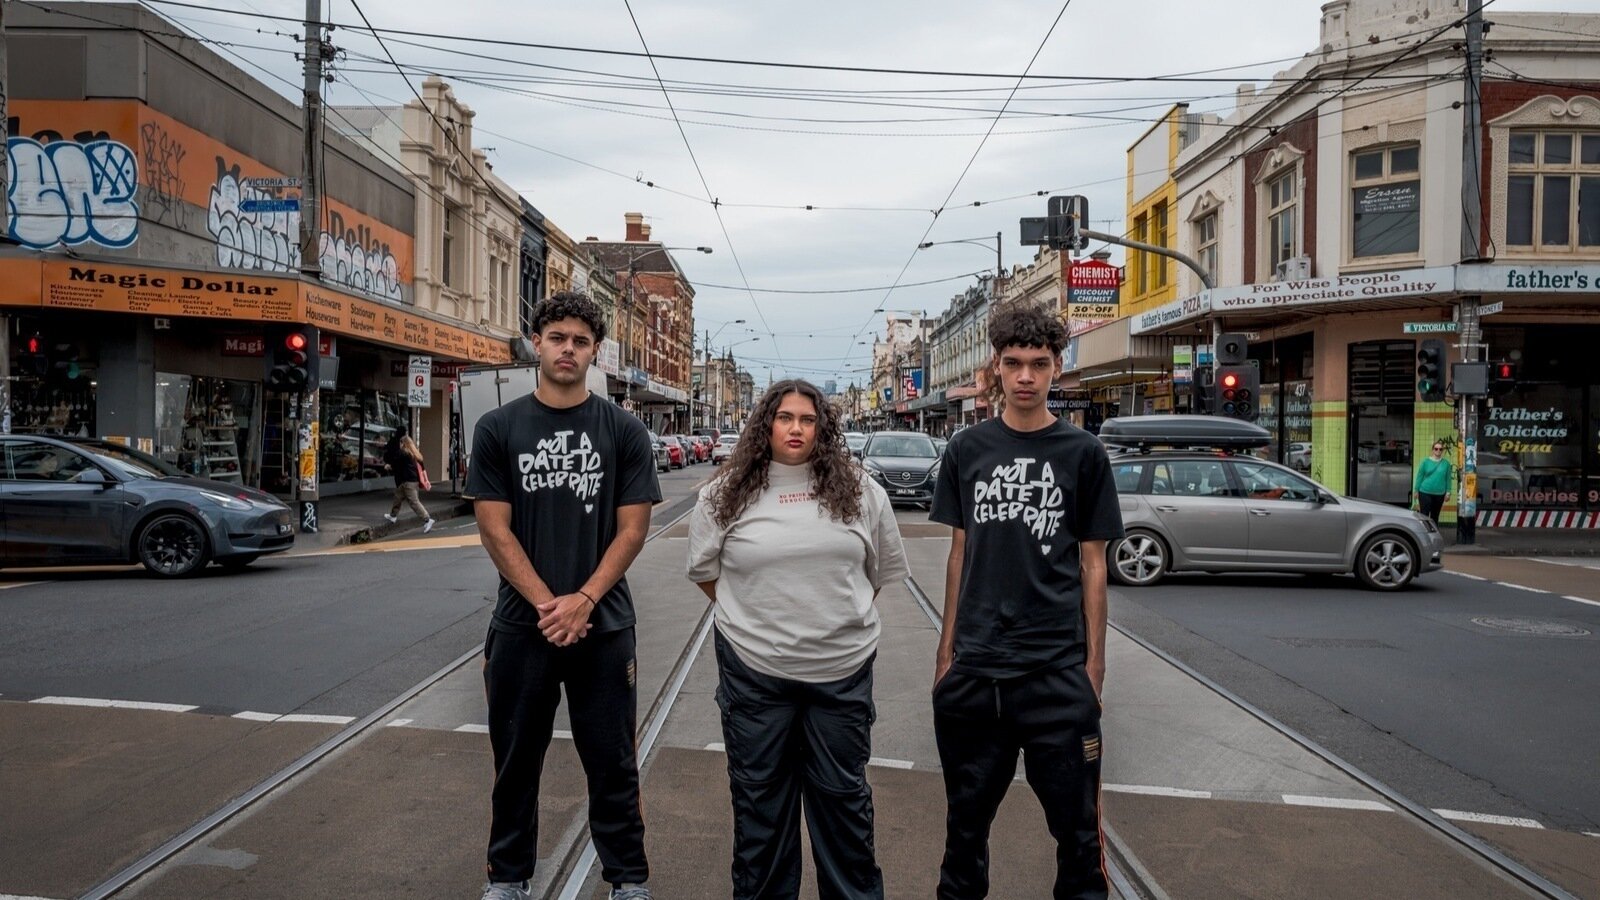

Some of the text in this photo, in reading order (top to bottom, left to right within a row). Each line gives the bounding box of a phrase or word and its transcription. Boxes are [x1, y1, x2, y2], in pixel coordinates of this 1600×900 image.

[248, 178, 297, 186] VICTORIA ST
[1072, 266, 1117, 278] CHEMIST
[1506, 270, 1588, 288] father's
[50, 284, 104, 293] Kitchenware
[69, 267, 278, 296] Magic Dollar
[1252, 272, 1401, 294] For Wise People
[50, 290, 102, 298] Housewares
[306, 290, 342, 312] Kitchenware
[1222, 296, 1257, 307] who
[1262, 288, 1354, 304] appreciate
[1362, 280, 1437, 296] Quality
[306, 306, 340, 326] Housewares
[1142, 310, 1161, 328] father's
[1162, 307, 1182, 321] famous
[1183, 296, 1201, 315] PIZZA
[350, 318, 375, 333] Hardware
[384, 313, 396, 328] Party
[404, 318, 429, 334] Games Toys
[1413, 324, 1446, 332] VICTORIA
[384, 326, 395, 338] Gifts
[404, 332, 412, 342] Arts
[417, 335, 429, 346] Crafts
[225, 339, 264, 354] Magi
[416, 376, 424, 386] C
[1294, 383, 1306, 397] 437
[1489, 407, 1563, 420] Father's
[1285, 416, 1312, 427] Deliciou
[1484, 424, 1568, 438] Delicious
[536, 430, 592, 454] NOT A
[1499, 440, 1553, 453] Pizza
[518, 449, 600, 474] DATE TO
[992, 458, 1054, 484] NOT A
[522, 471, 604, 501] CELEBRATE
[974, 477, 1063, 508] DATE TO
[1490, 489, 1600, 502] Deliveries 9
[974, 501, 1065, 540] CELEBRATE
